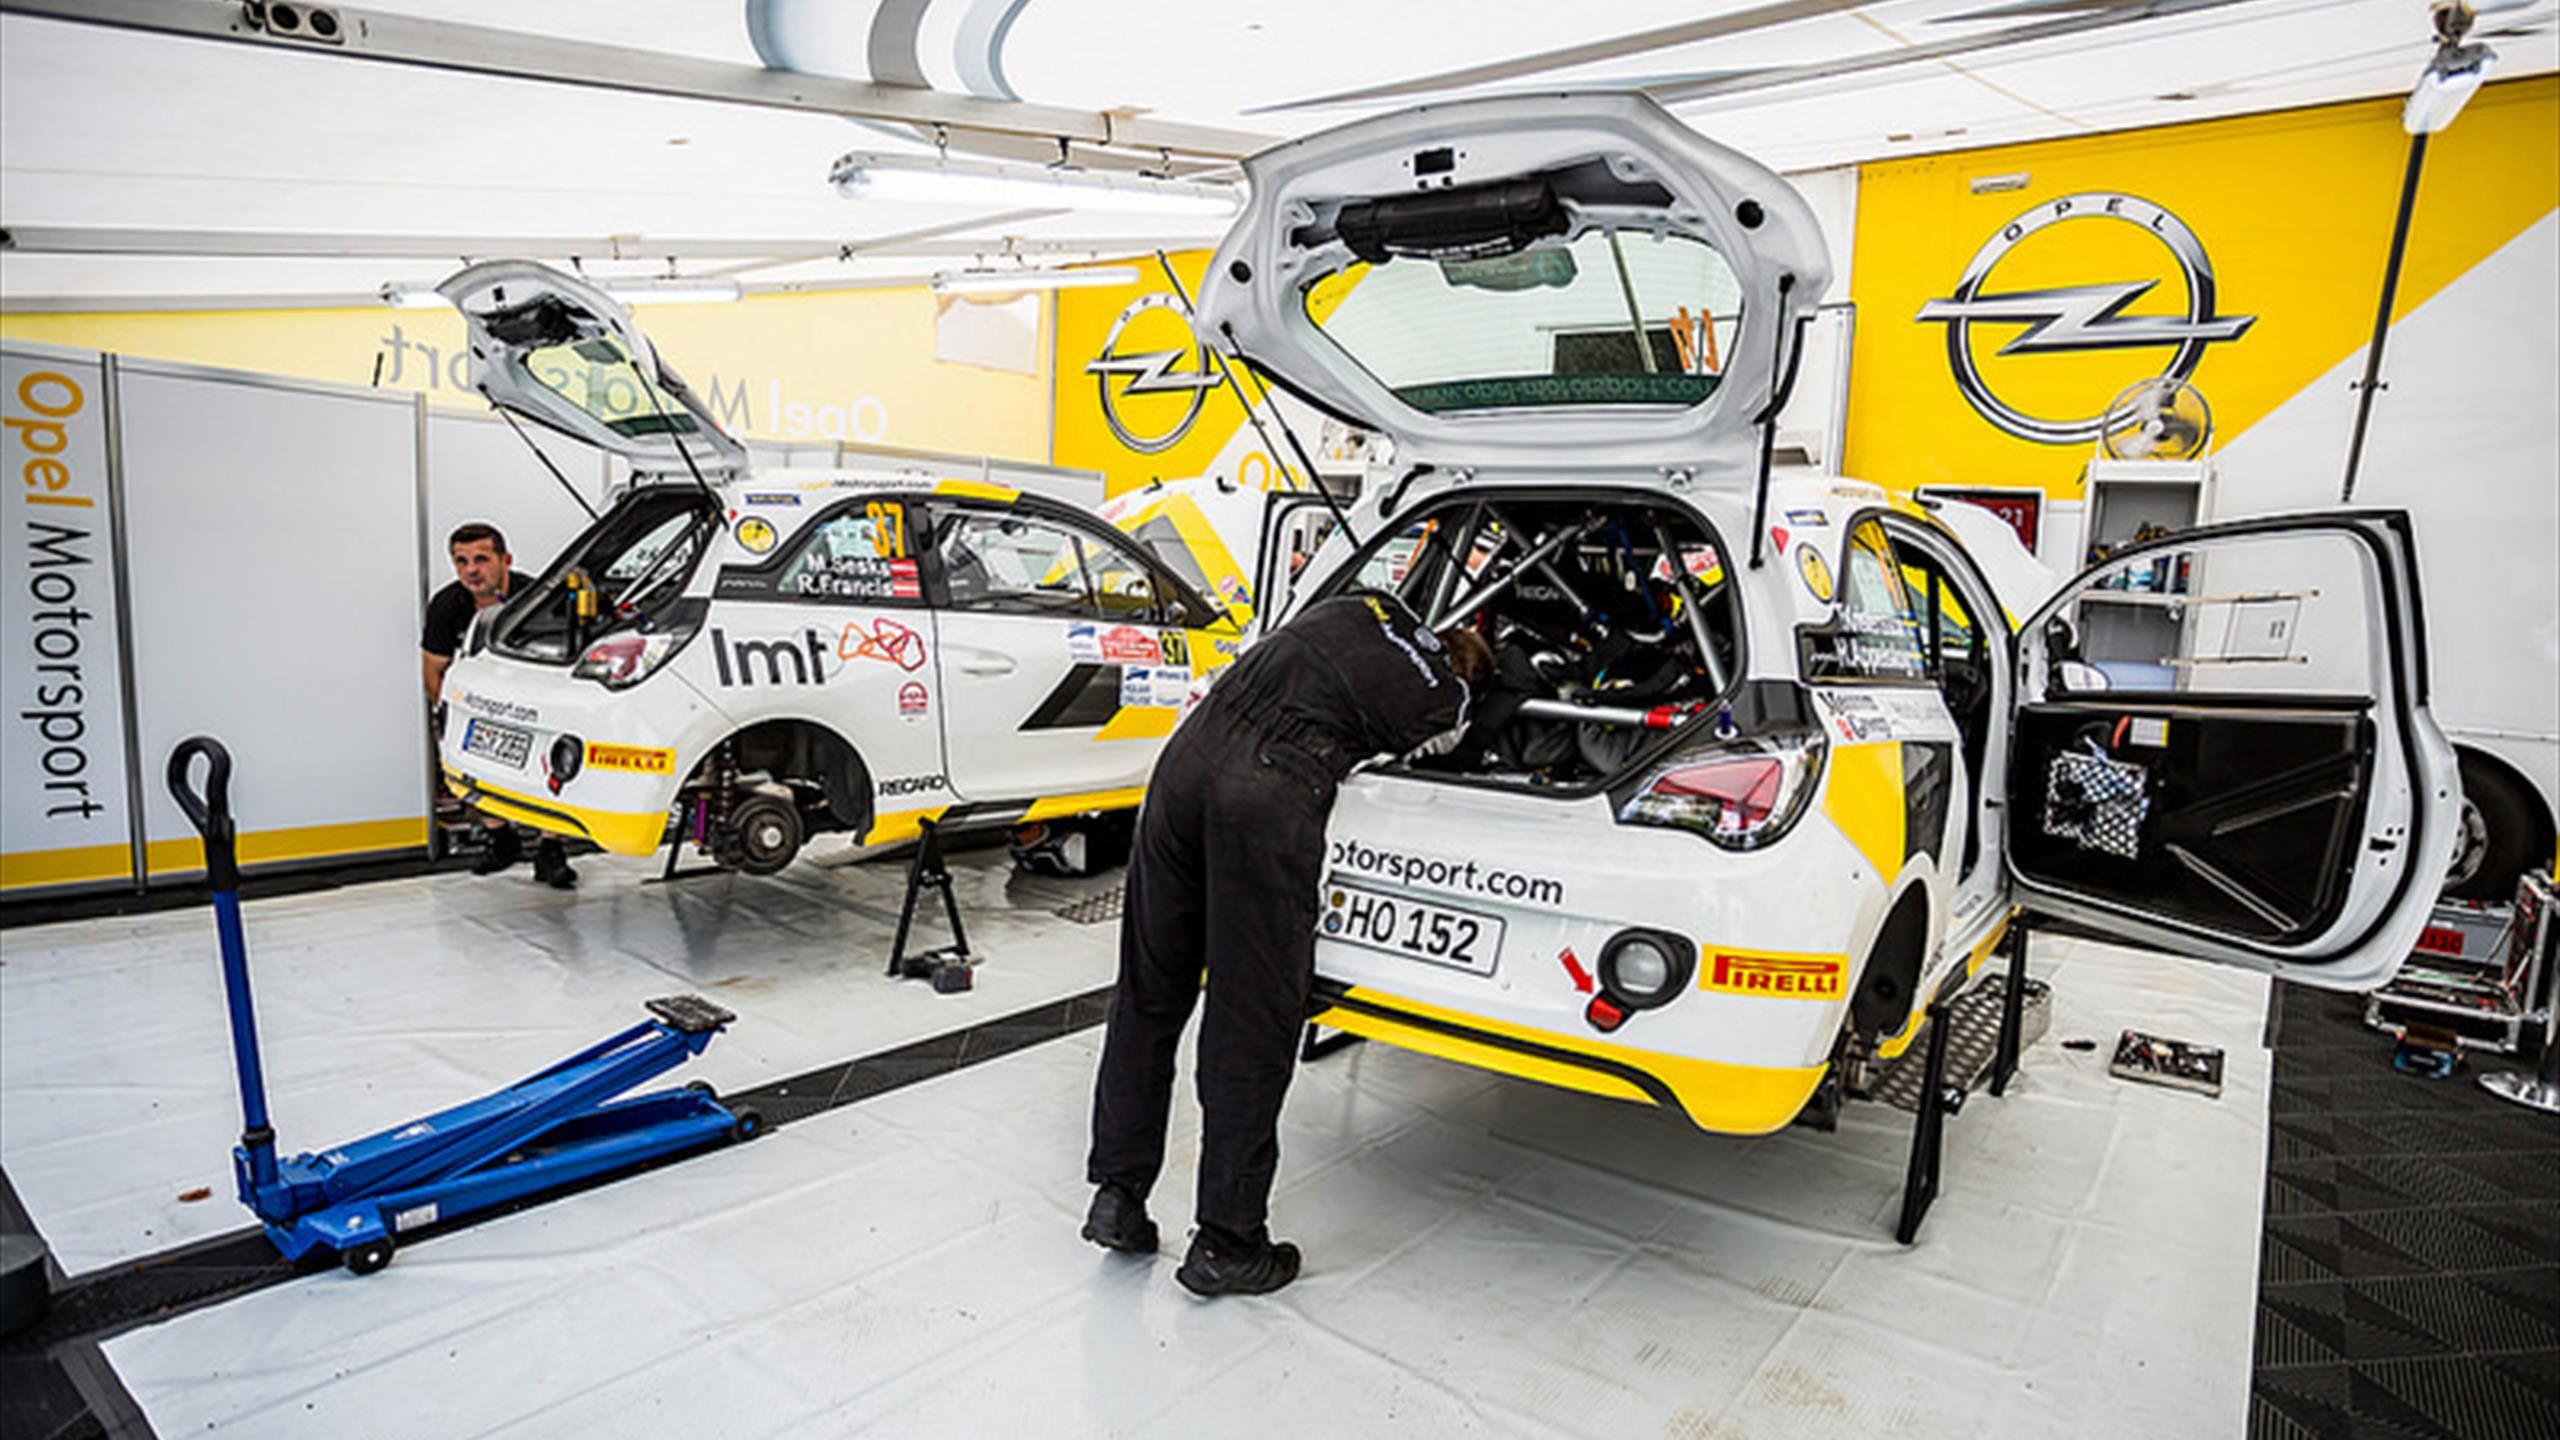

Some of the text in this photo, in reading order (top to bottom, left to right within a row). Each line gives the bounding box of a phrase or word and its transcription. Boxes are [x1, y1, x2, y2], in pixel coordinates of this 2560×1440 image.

[2003, 197, 2165, 242] OPEL
[866, 501, 905, 559] 37
[3, 371, 104, 819] Opel Motorsport
[1160, 630, 1187, 665] 37
[879, 773, 948, 798] RECARO
[1332, 840, 1564, 905] otorsport.com
[1345, 893, 1480, 964] HO 152
[1711, 954, 1840, 993] PIRELLI
